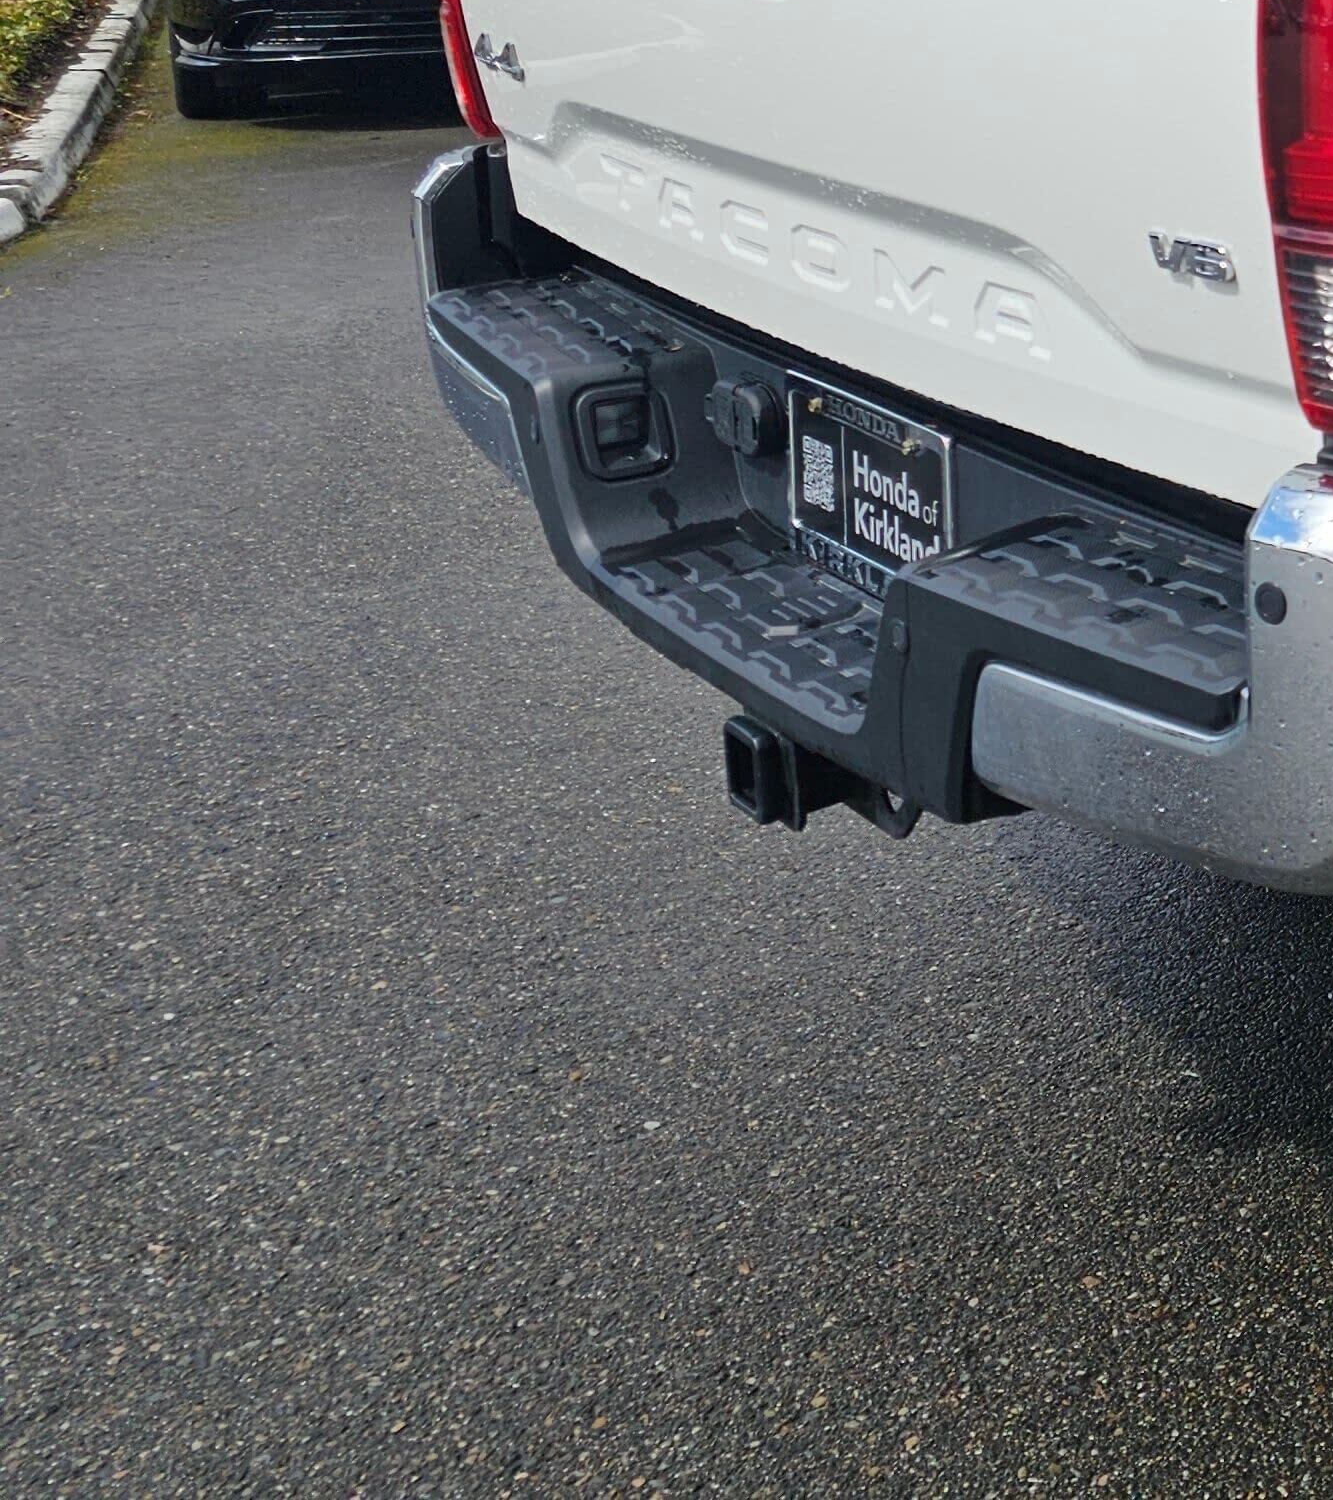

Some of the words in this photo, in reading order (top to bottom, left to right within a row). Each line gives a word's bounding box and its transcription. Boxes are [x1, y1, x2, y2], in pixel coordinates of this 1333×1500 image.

[600, 153, 1052, 361] TACOMA
[1147, 231, 1238, 283] V6
[827, 395, 901, 442] HONDA
[852, 450, 920, 519] Honda
[923, 500, 939, 527] of
[854, 497, 941, 564] Kirkland
